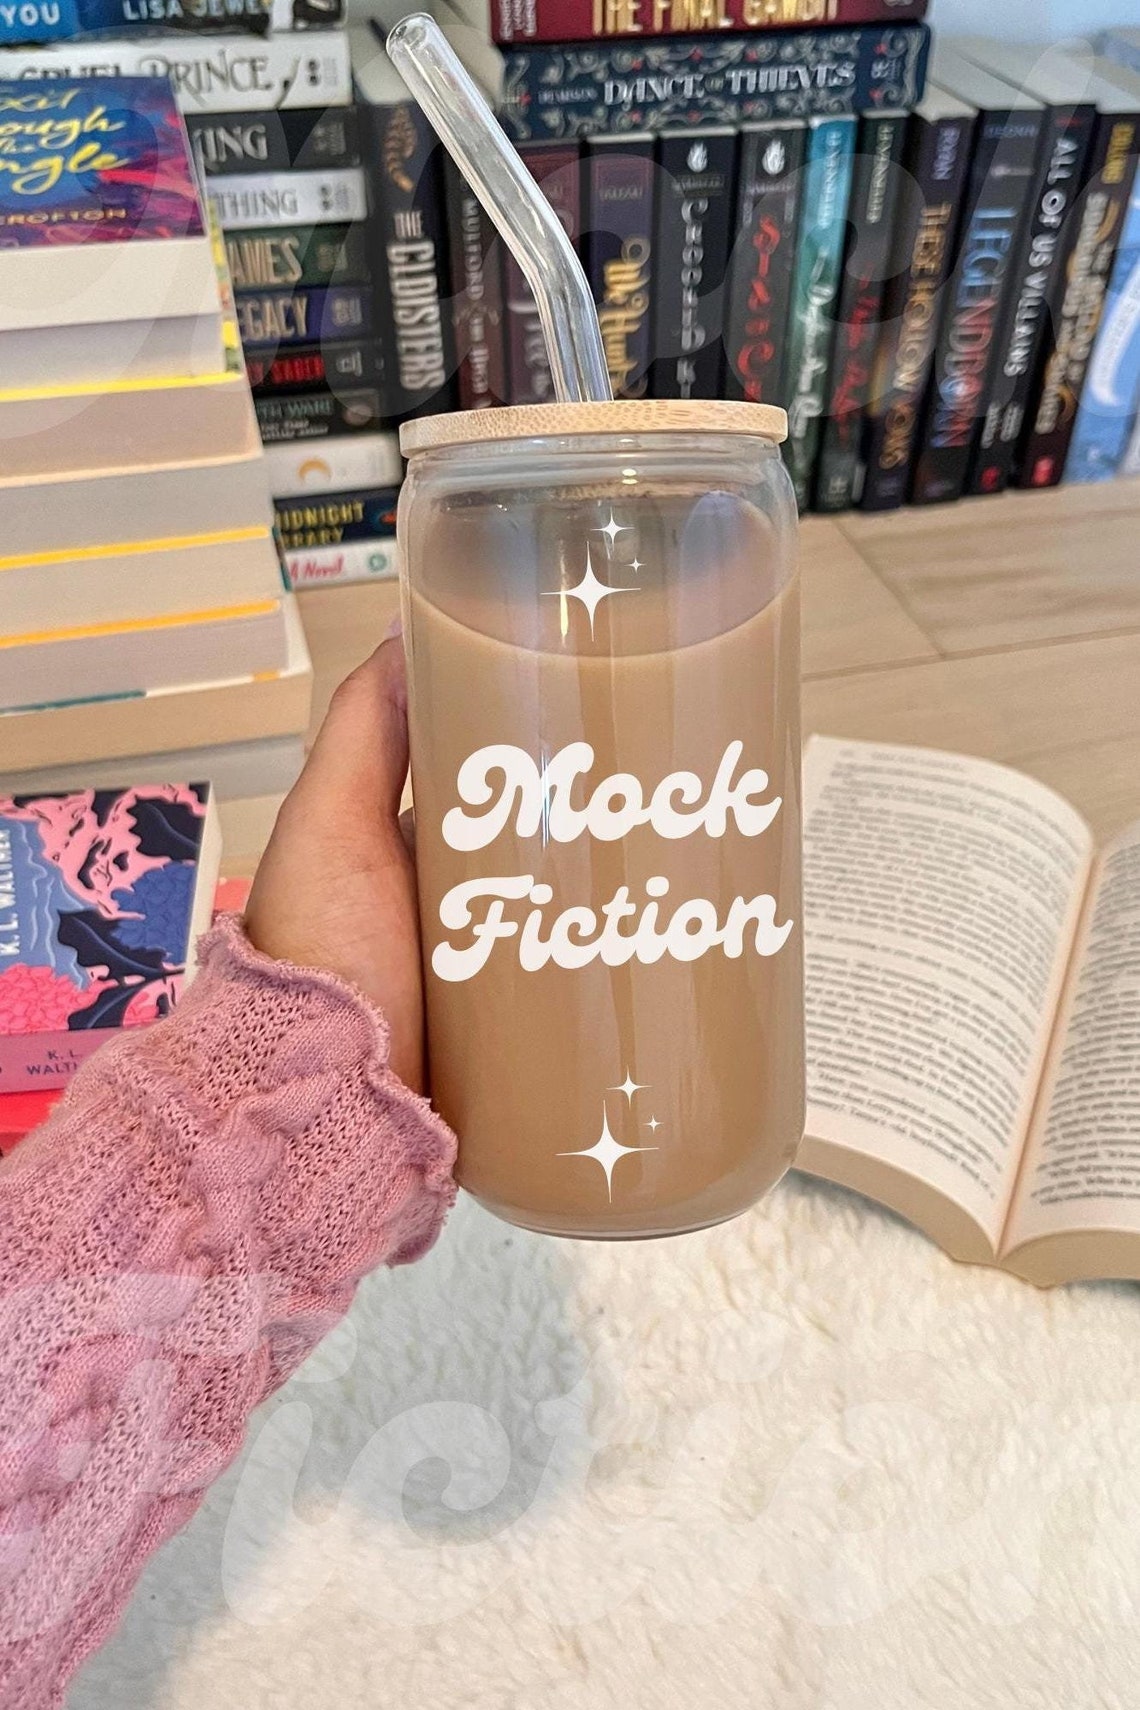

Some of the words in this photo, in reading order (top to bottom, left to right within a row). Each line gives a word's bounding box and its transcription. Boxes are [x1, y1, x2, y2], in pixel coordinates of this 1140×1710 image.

[0, 3, 60, 26] YOU
[121, 0, 185, 21] LISA
[138, 49, 275, 104] PRINCE
[1047, 137, 1079, 185] ALL
[0, 207, 127, 226] ROFTON
[1038, 189, 1067, 229] OF
[1027, 233, 1058, 268] US
[1002, 271, 1048, 377] VILLAINS
[442, 740, 782, 851] Mock
[431, 874, 794, 982] Fiction
